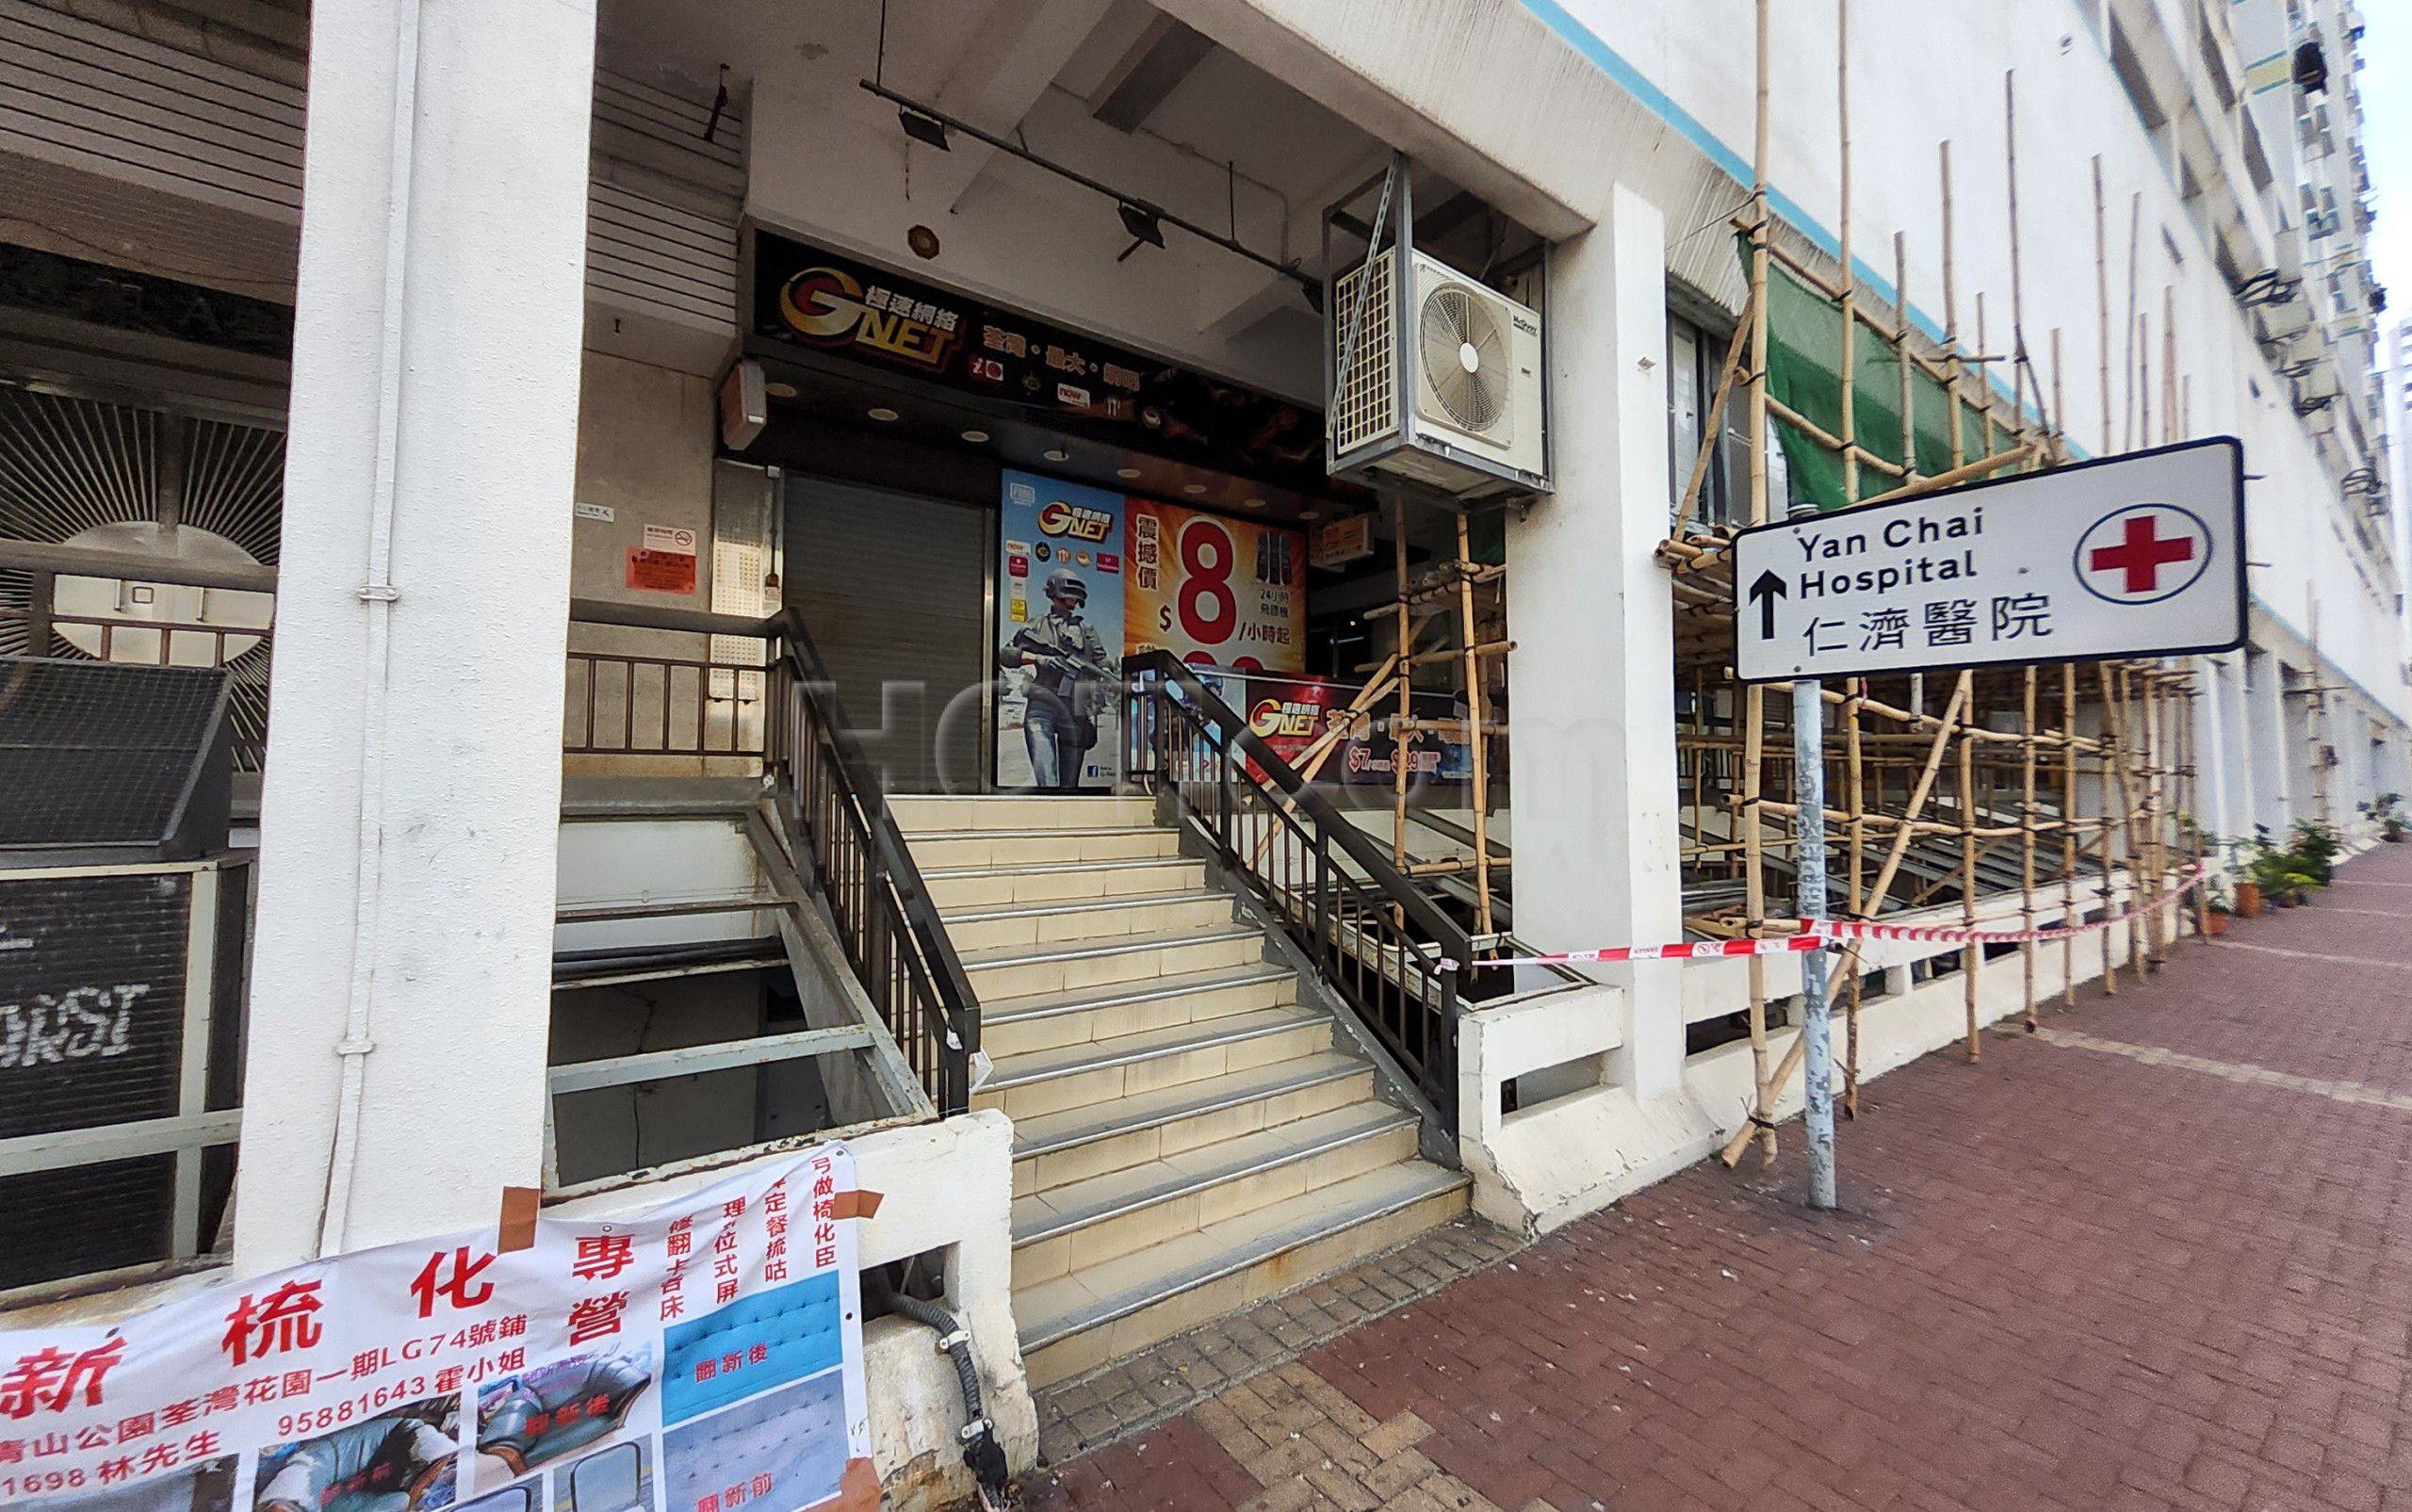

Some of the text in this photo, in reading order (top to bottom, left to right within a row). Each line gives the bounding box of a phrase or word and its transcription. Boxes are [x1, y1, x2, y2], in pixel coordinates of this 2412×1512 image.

[865, 285, 959, 333] 極速網絡
[1059, 387, 1083, 402] now
[1797, 506, 1983, 562] Yan Chai
[1800, 549, 1978, 600] Hospital
[1802, 592, 2053, 658] 仁濟醫院
[696, 1342, 769, 1383] 翻新後
[2, 1346, 527, 1496] 1698 林先生 95881643 霍小姐
